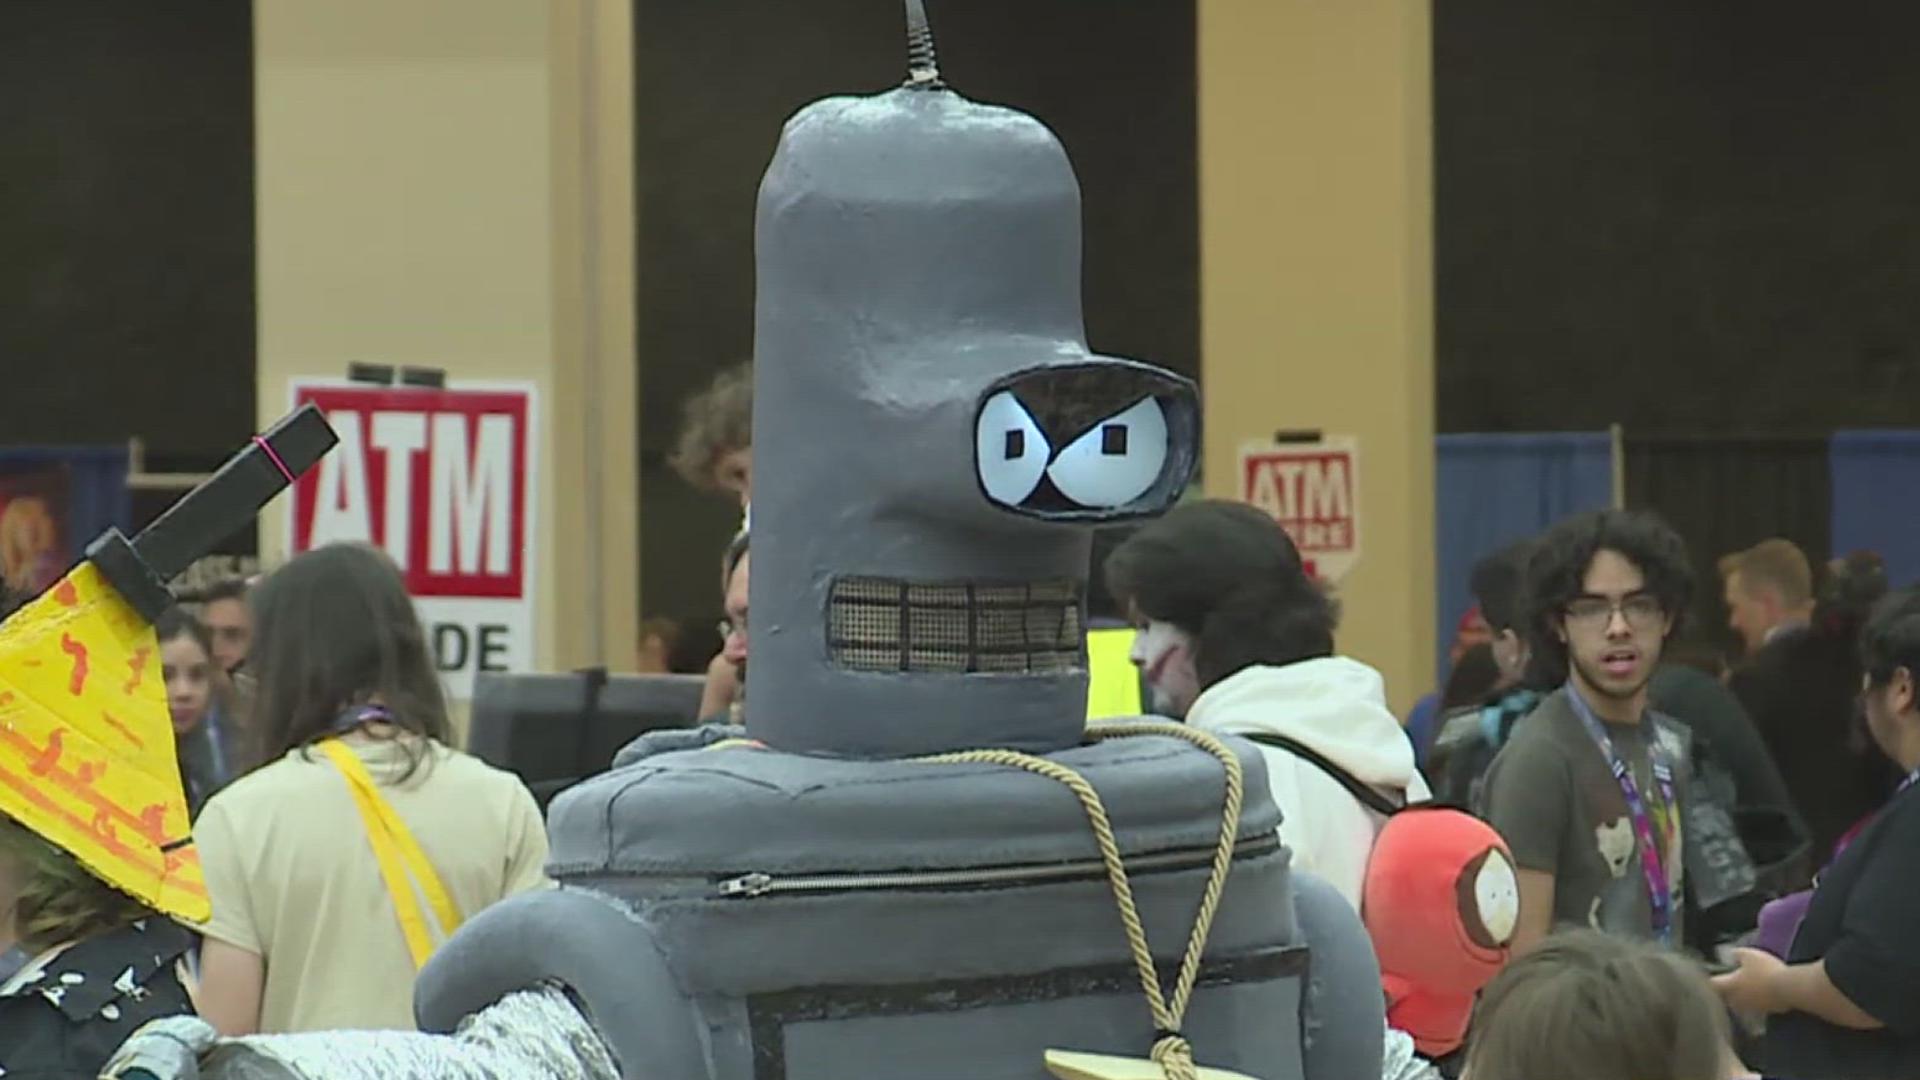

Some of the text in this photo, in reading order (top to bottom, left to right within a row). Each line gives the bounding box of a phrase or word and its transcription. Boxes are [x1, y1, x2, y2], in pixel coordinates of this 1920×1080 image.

[309, 409, 514, 576] ATM
[1252, 461, 1350, 518] ATM
[434, 623, 509, 672] DE
